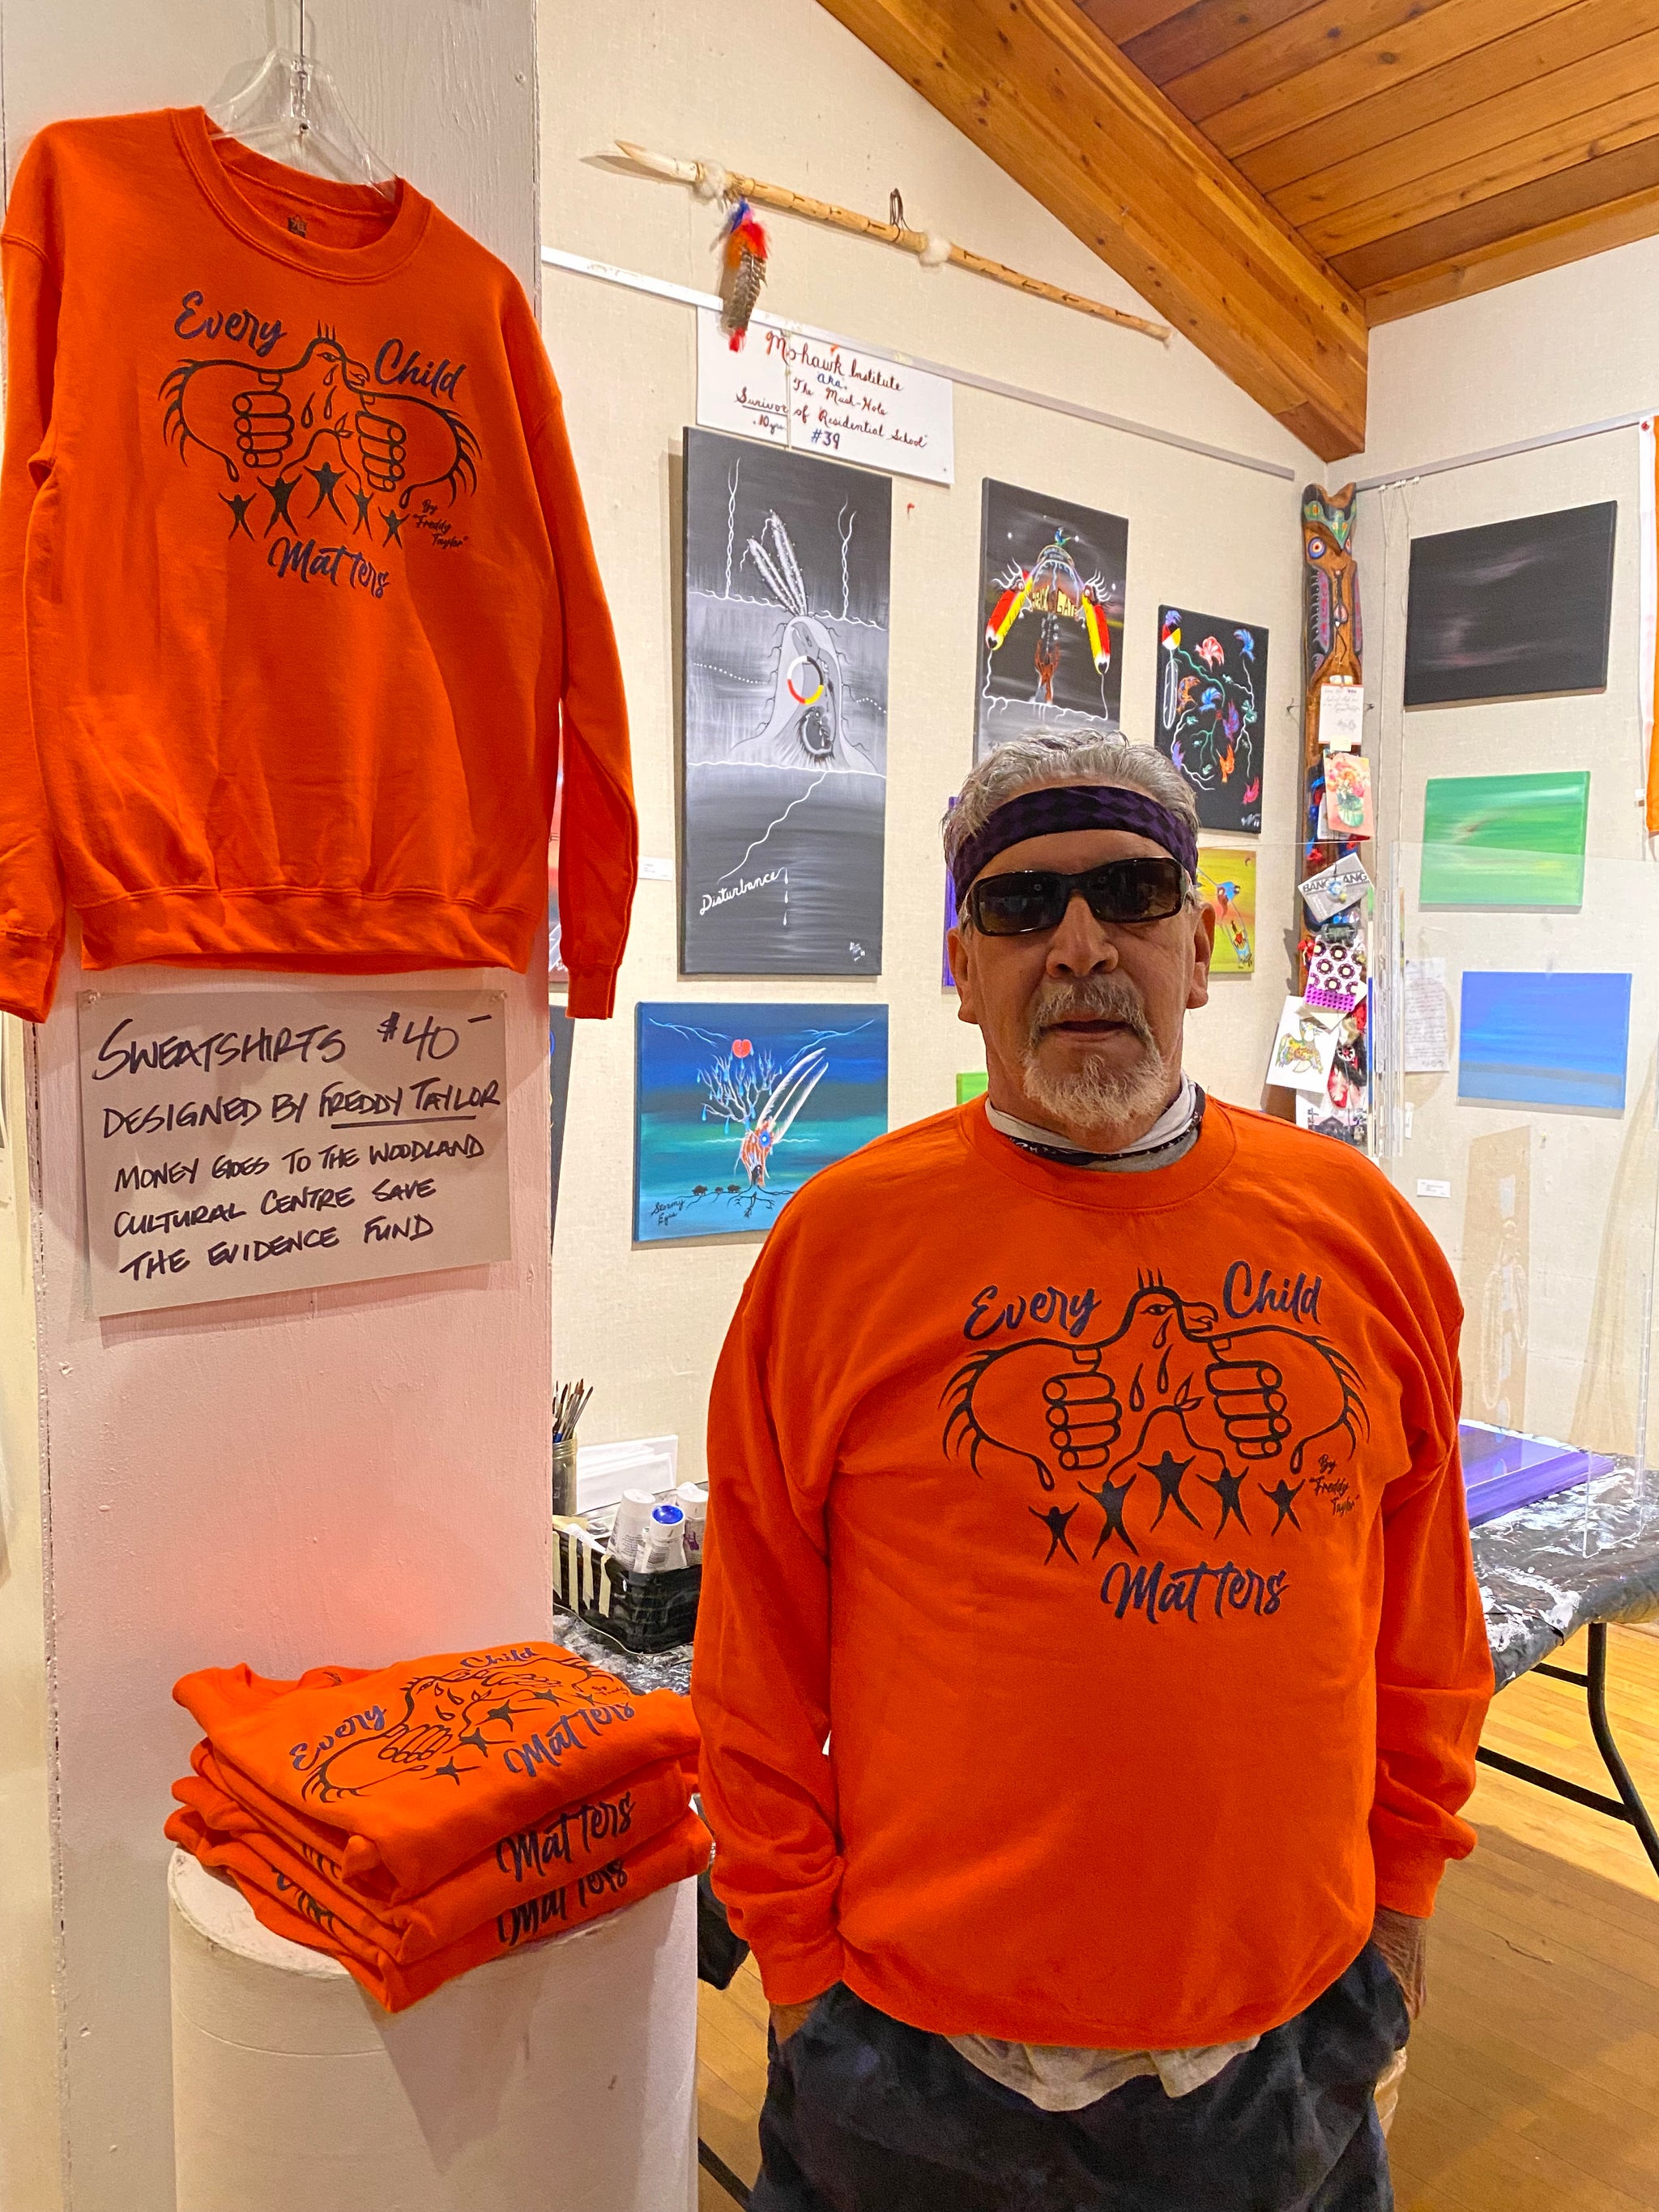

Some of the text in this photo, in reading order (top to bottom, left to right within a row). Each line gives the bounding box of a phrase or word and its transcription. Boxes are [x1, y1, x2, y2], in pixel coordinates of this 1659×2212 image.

[174, 290, 287, 357] Every
[374, 339, 466, 402] Child
[766, 330, 905, 391] Mohawk Institute
[793, 377, 814, 395] The
[793, 405, 809, 424] of
[811, 428, 841, 450] #39
[267, 536, 390, 599] Matters
[700, 870, 780, 915] Disturbance
[1342, 872, 1368, 884] ANG
[92, 1018, 347, 1080] SWEATSHIRTS
[103, 1077, 501, 1138] DESIGNED BY FREDDY TAYLOR
[115, 1134, 484, 1193] MONEY GOES TO THE WOODLAND
[114, 1178, 437, 1238] CULTURAL CENTRE SAVE
[120, 1213, 433, 1281] THE EVIDENCE FUND
[963, 1260, 1322, 1341] Every Child
[1318, 1454, 1337, 1474] By
[1100, 1561, 1290, 1624] Matters
[460, 1647, 541, 1669] Child
[289, 1705, 387, 1772] Every
[502, 1702, 635, 1778] Matters
[496, 1791, 637, 1882] Matters
